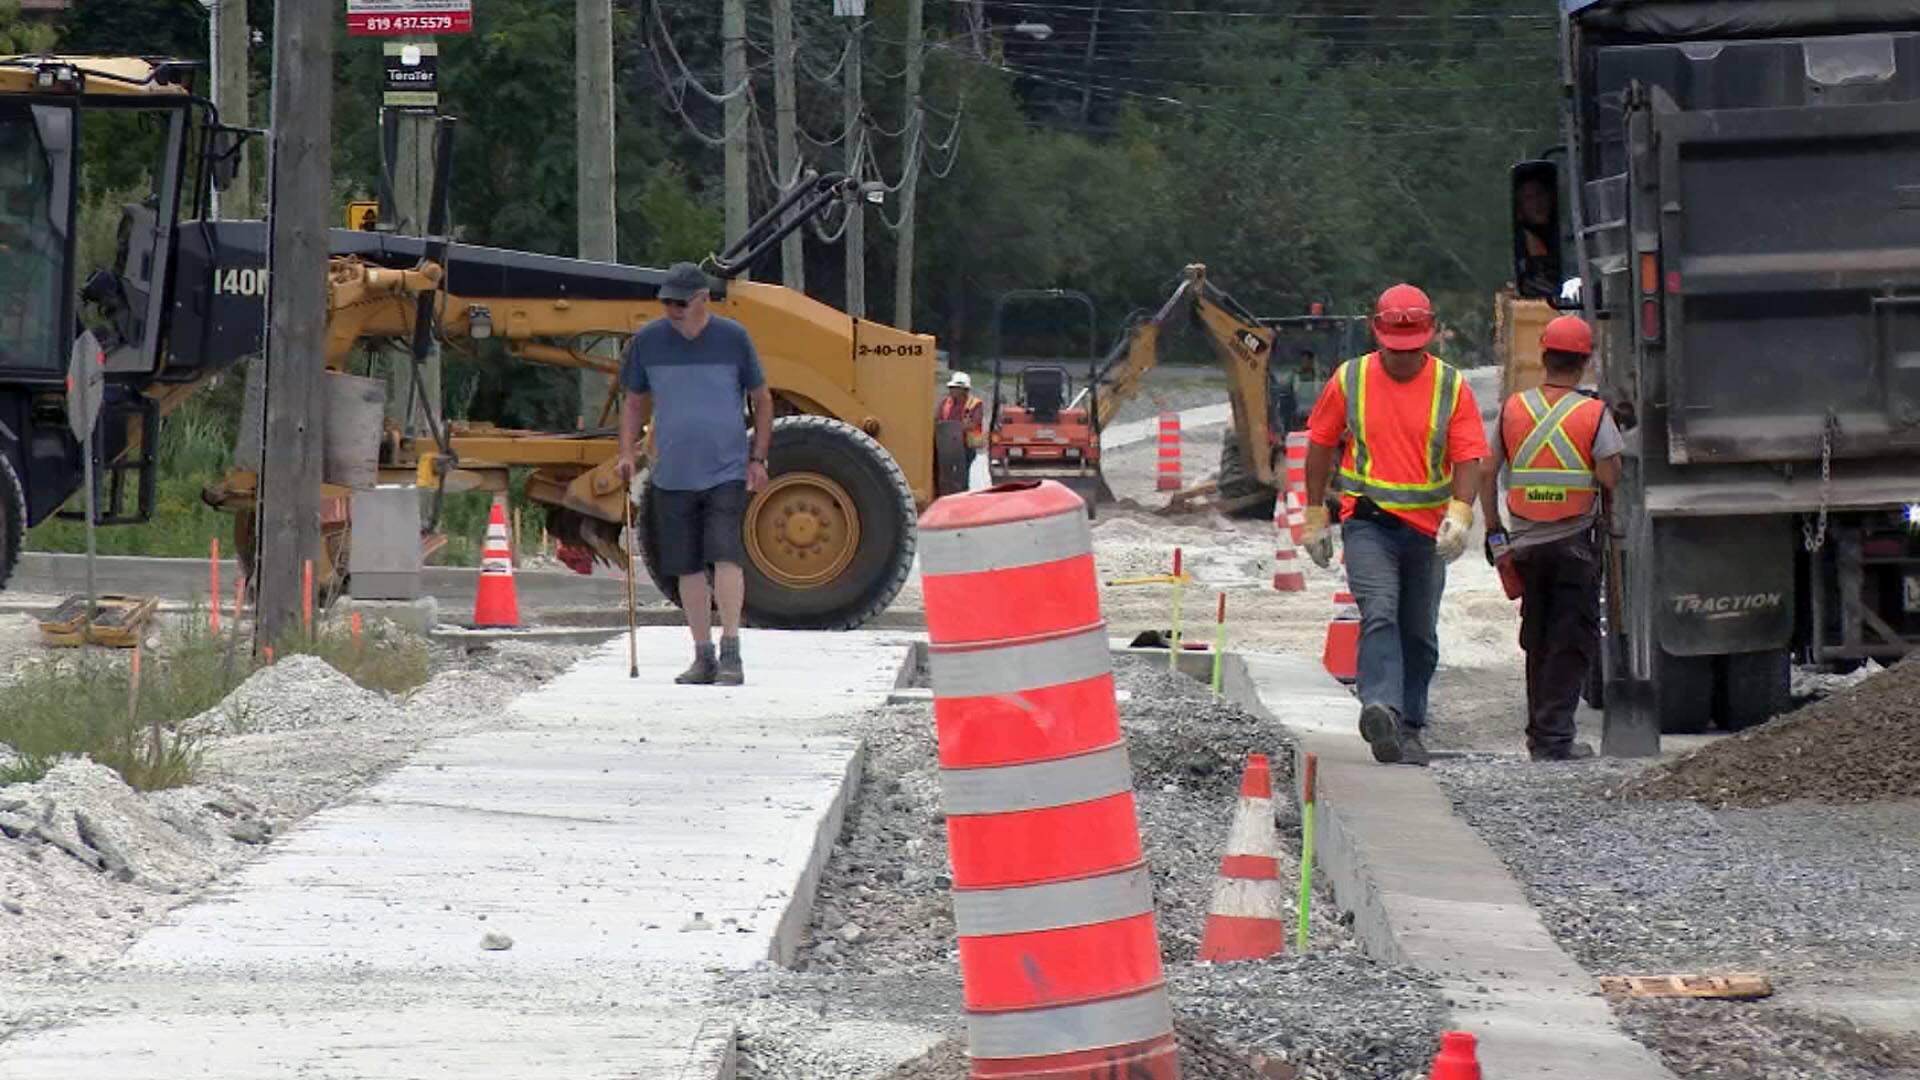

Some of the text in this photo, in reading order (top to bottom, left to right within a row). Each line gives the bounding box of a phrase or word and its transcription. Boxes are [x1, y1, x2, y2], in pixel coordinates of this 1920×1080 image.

[367, 16, 452, 31] 819 437.5579
[858, 344, 923, 357] 2-40-013
[1671, 592, 1782, 614] TRACTION
